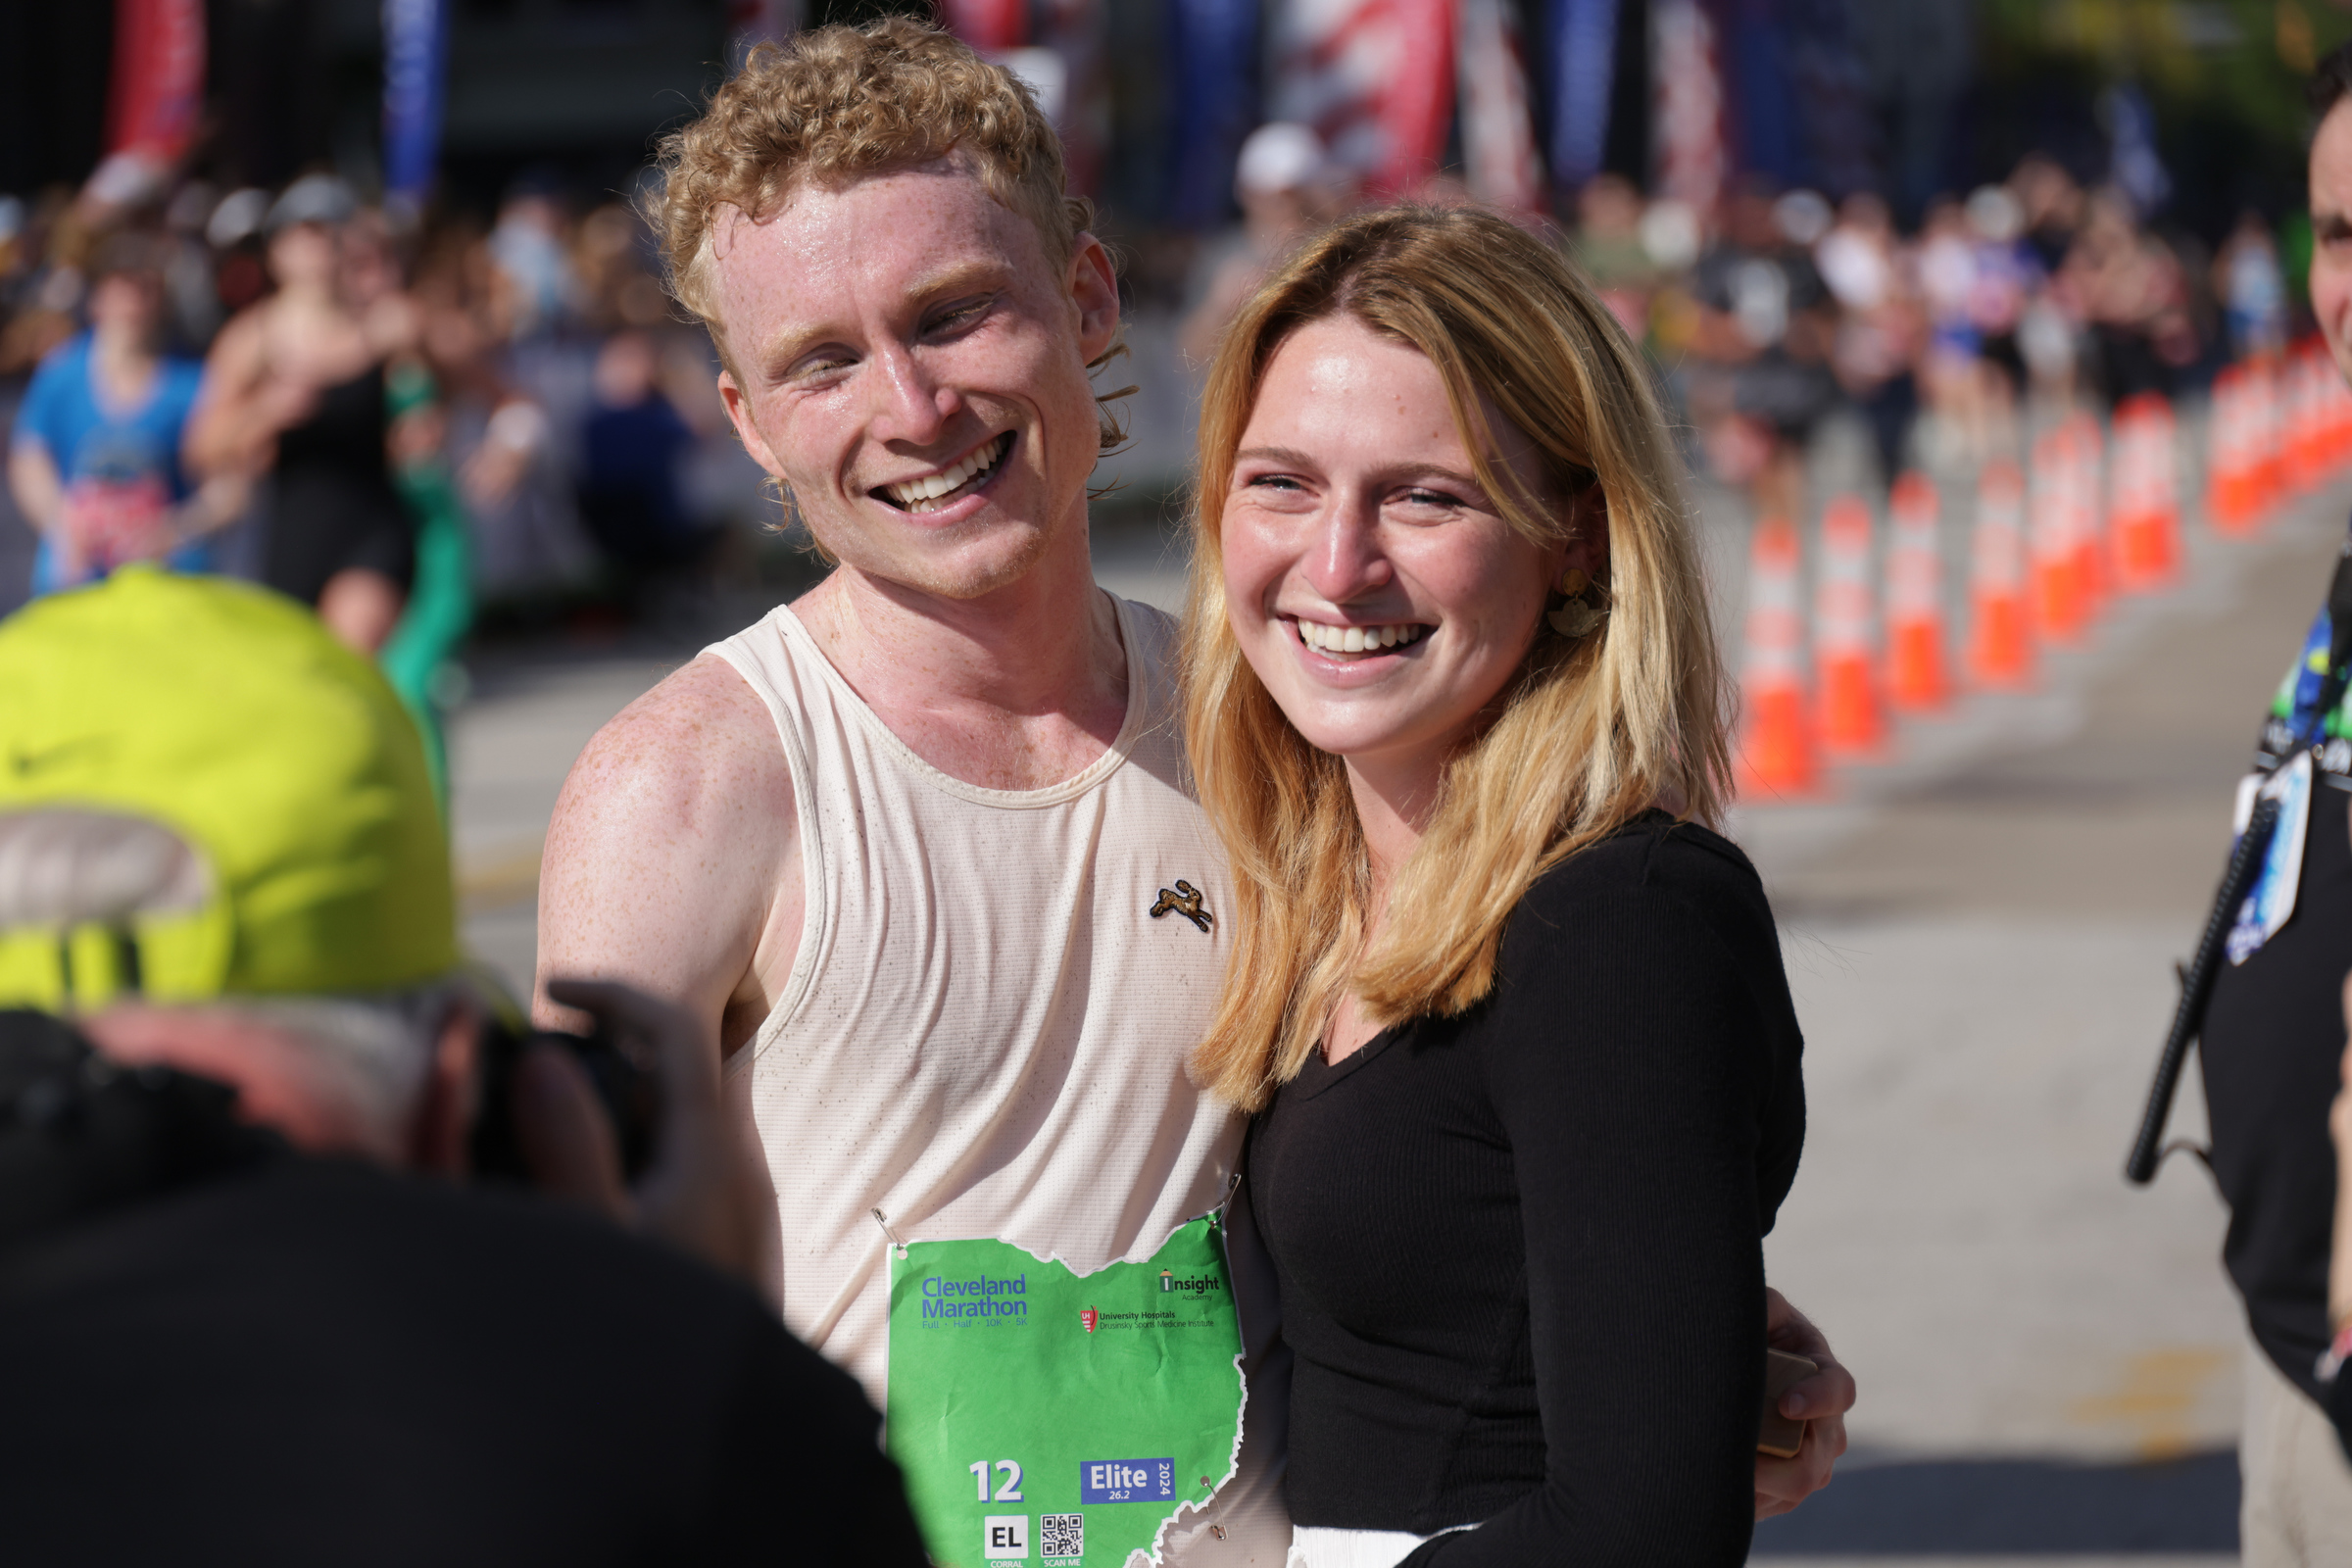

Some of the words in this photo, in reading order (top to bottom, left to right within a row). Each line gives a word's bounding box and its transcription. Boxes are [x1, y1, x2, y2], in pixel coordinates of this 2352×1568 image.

[921, 1273, 1026, 1298] Cleveland
[921, 1296, 1027, 1318] Marathon
[1100, 1312, 1139, 1321] University
[1141, 1310, 1176, 1320] Hospitals
[922, 1320, 940, 1329] Full
[954, 1319, 973, 1328] Half
[986, 1318, 1003, 1327] 10K
[1016, 1317, 1028, 1326] 5K
[1100, 1321, 1133, 1330] Drusinsky
[1156, 1319, 1186, 1328] Medicine
[968, 1459, 1025, 1503] 12
[1091, 1464, 1148, 1490] Elite
[1158, 1463, 1171, 1495] 2024
[1108, 1490, 1130, 1499] 26.2
[992, 1526, 1022, 1547] EL
[1067, 1558, 1081, 1567] ME
